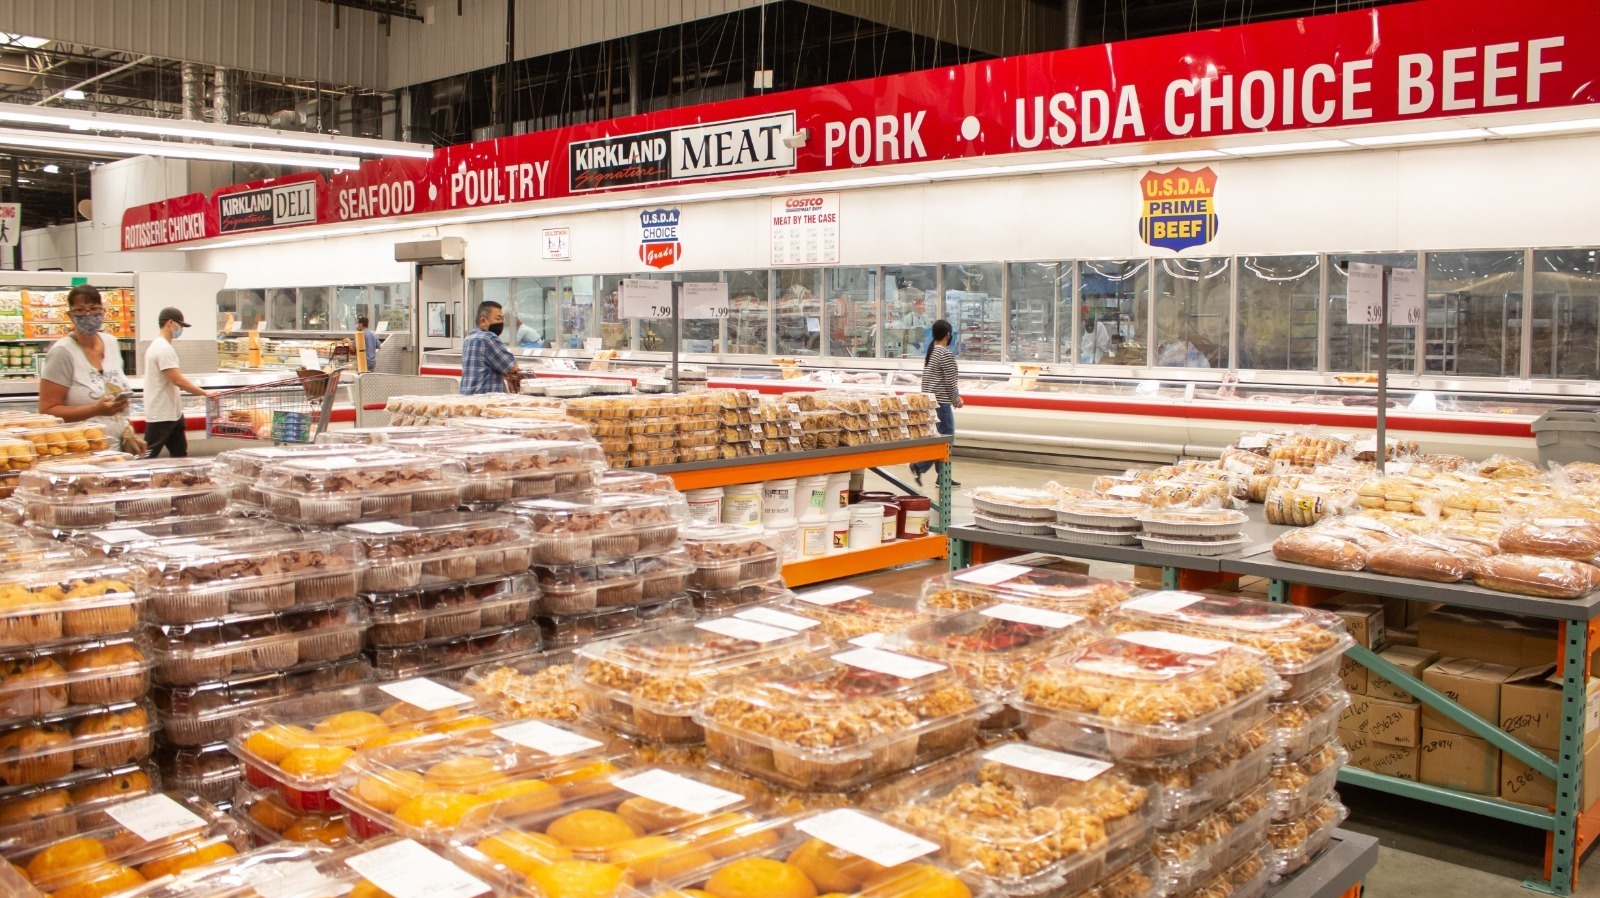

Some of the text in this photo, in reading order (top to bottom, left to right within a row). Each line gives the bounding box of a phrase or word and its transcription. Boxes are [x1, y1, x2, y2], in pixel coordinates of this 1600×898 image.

[1016, 36, 1565, 148] USDA CHOICE BEEF
[575, 124, 782, 172] KIRKLAND MEAT
[825, 110, 927, 167] PORK
[574, 166, 666, 189] Signature
[1146, 176, 1211, 197] U.S.D.A.
[339, 160, 550, 220] SEAFOOD POULTRY
[222, 188, 311, 219] KIRKLAND DELI
[1149, 200, 1207, 215] PRIME
[222, 214, 272, 231] Signature
[642, 212, 678, 225] U.S.D.A.
[773, 213, 836, 226] MEAT BY THE CASE
[125, 212, 206, 249] ROTISSERIE CHICKEN
[643, 227, 677, 239] CHOICE
[1153, 220, 1203, 239] BEEF
[647, 246, 673, 265] Grade
[651, 306, 671, 317] 7.99
[709, 307, 729, 318] 7.99
[1367, 305, 1382, 322] 5.99
[1407, 308, 1421, 323] 6.99
[1369, 711, 1403, 738] 1056231
[1371, 748, 1410, 770] 1440863
